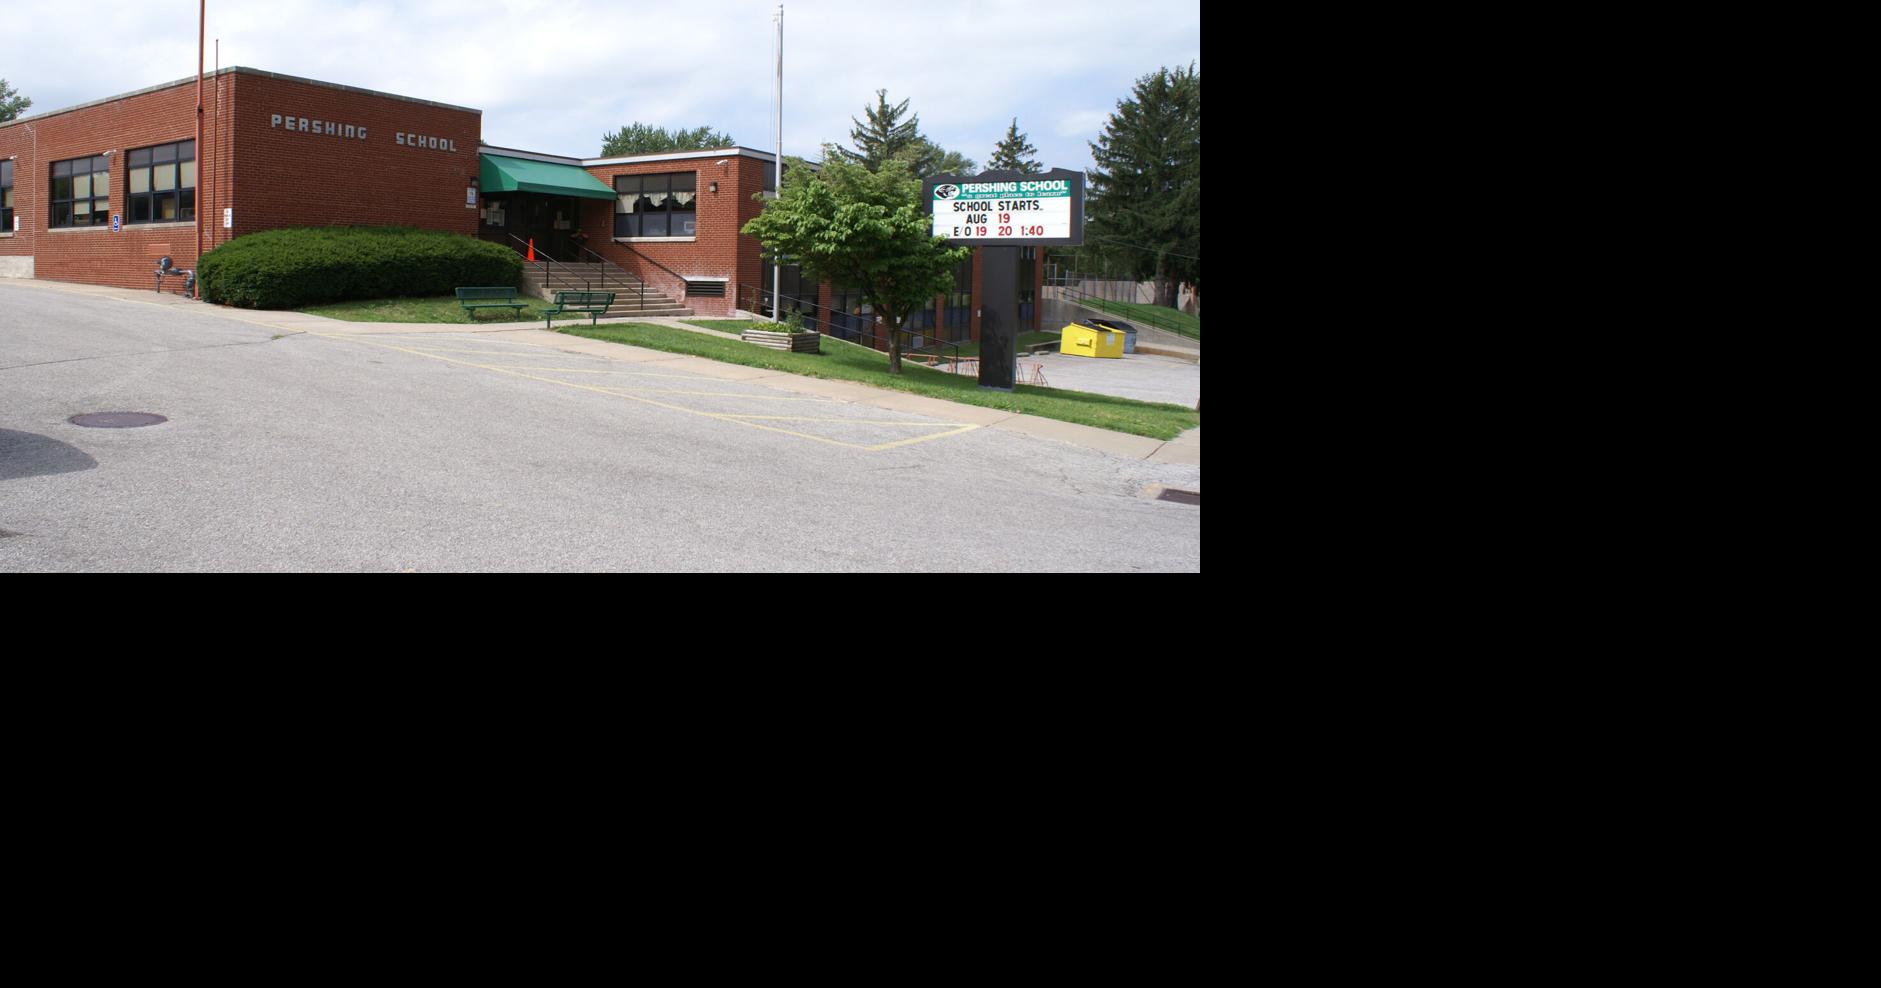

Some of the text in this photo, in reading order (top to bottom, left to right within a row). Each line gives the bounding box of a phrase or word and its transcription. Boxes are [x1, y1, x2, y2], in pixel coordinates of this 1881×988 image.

[271, 114, 457, 152] PERSHING SCHOOL
[962, 180, 1068, 193] PERSHING SCHOOL
[953, 201, 993, 212] SCHOOL
[966, 213, 1011, 224] AUG 19
[976, 226, 987, 236] 19
[998, 226, 1012, 236] 20
[1021, 225, 1044, 236] 1:40
